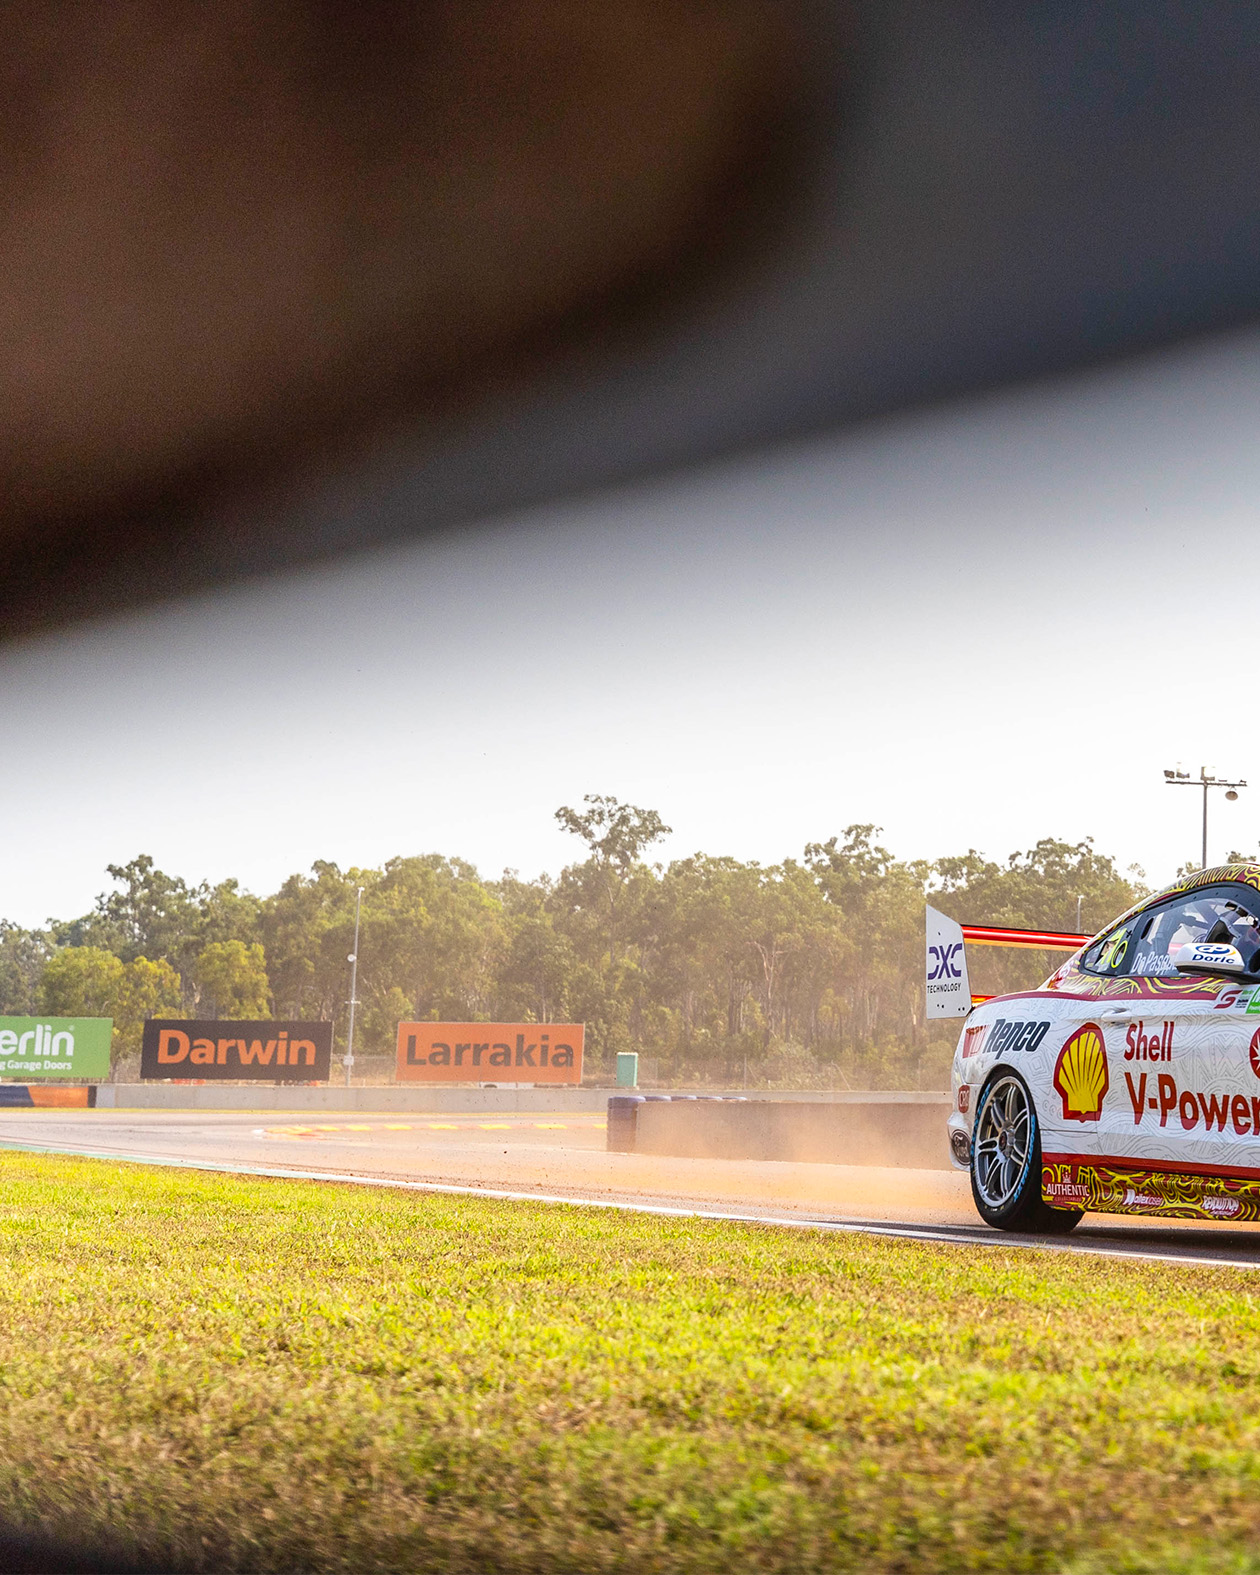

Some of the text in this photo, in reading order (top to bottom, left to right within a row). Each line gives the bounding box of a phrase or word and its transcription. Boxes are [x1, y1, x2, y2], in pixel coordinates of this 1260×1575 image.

[928, 943, 962, 980] DXC
[1192, 954, 1235, 965] Doric
[927, 983, 961, 994] TECHNOLOGY
[157, 1029, 316, 1066] Darwin
[406, 1034, 574, 1068] Larrakia
[983, 1018, 1051, 1060] Repco
[1124, 1021, 1174, 1061] Shell
[7, 1060, 42, 1072] Garage
[43, 1060, 72, 1070] Doors
[1046, 1183, 1090, 1197] AUTHENTIC
